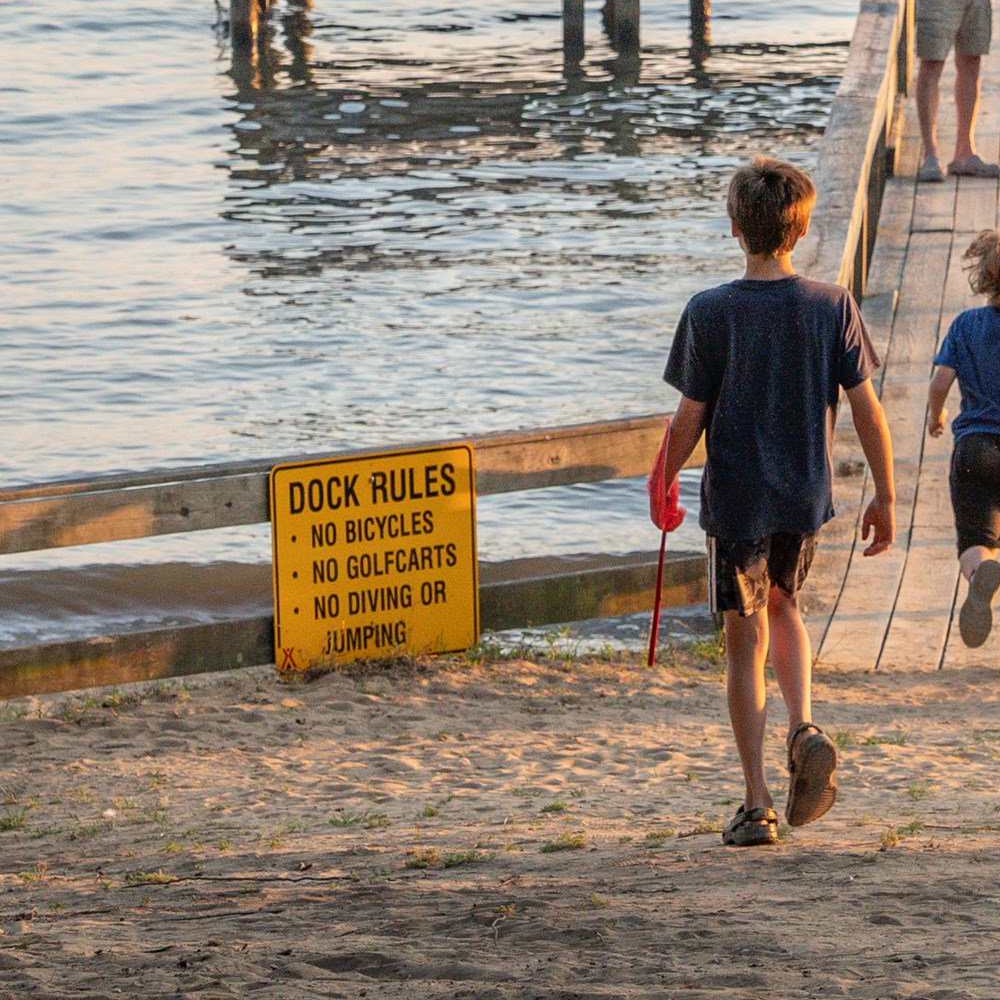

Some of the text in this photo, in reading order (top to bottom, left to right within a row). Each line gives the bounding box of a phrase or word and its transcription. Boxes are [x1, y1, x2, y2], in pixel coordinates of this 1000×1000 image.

[289, 463, 456, 515] DOCK RULES
[311, 510, 434, 548] NO BICYCLES
[312, 543, 457, 584] NO GOLFCARTS
[314, 580, 447, 620] NO DIVING OR
[323, 621, 406, 655] JUMPING
